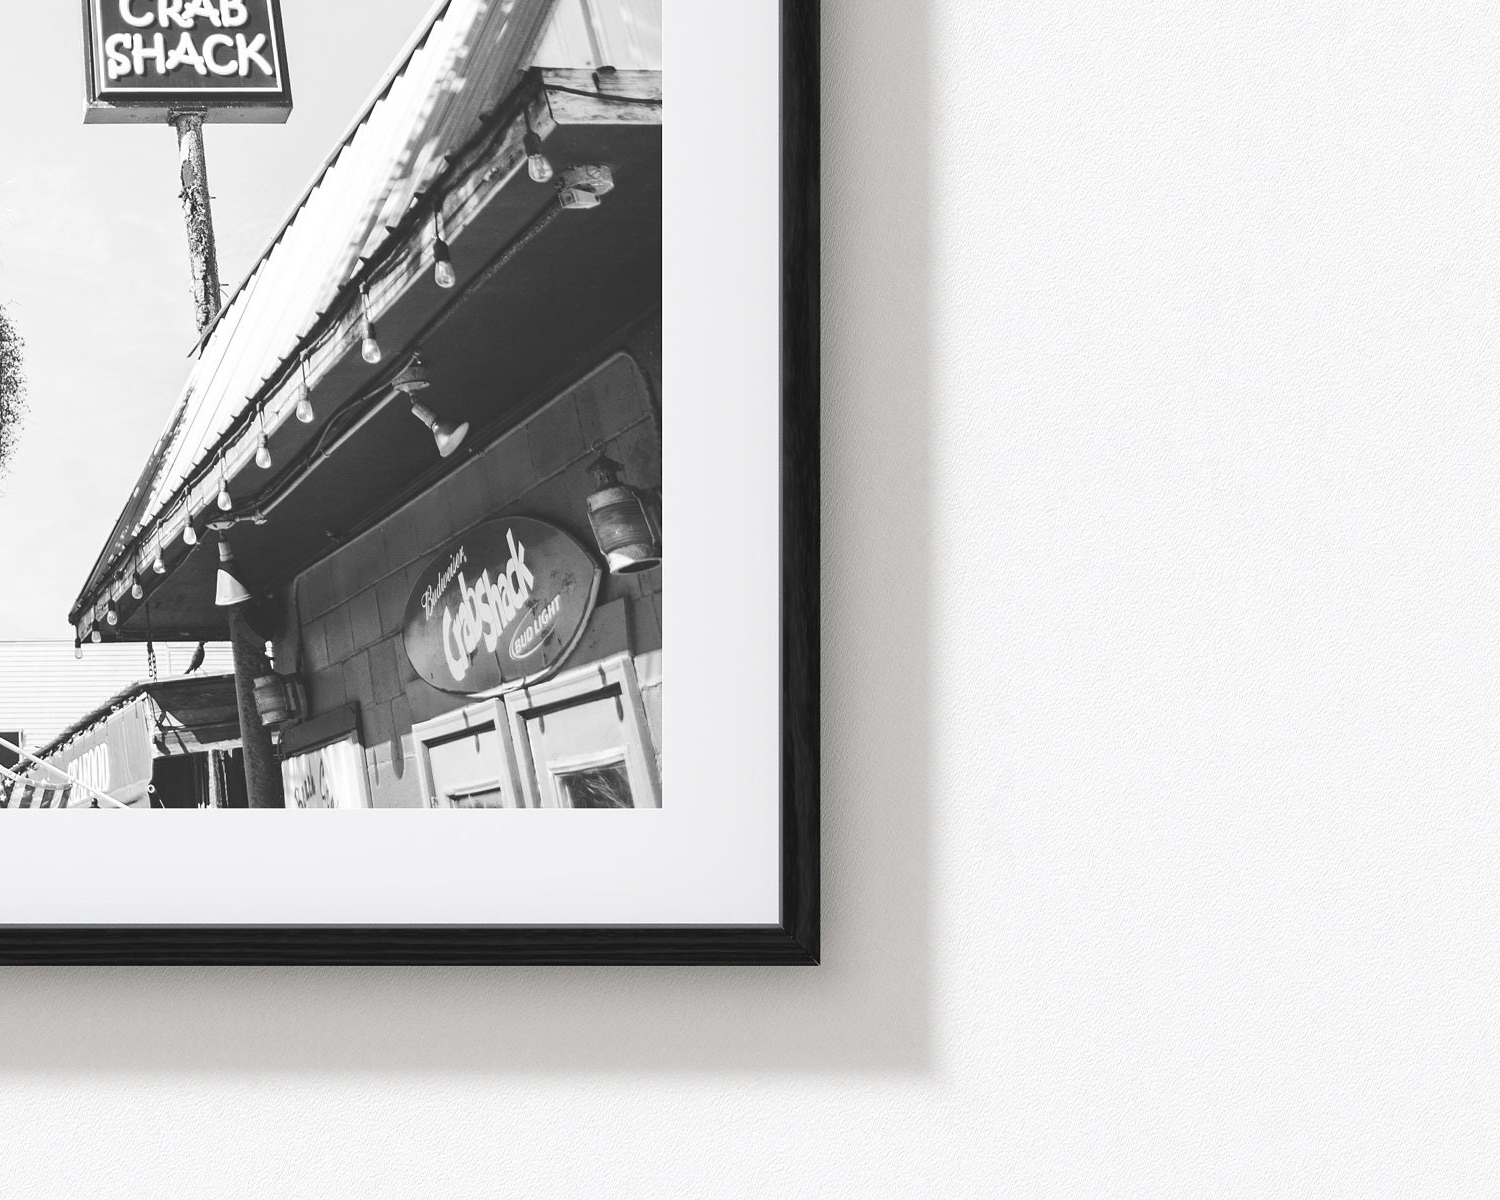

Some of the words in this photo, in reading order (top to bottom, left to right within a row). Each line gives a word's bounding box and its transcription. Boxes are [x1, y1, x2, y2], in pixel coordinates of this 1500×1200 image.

[105, 32, 274, 79] SHACK
[421, 545, 467, 621] Budweiser
[514, 625, 533, 655] BUD
[533, 594, 561, 635] LIGHT
